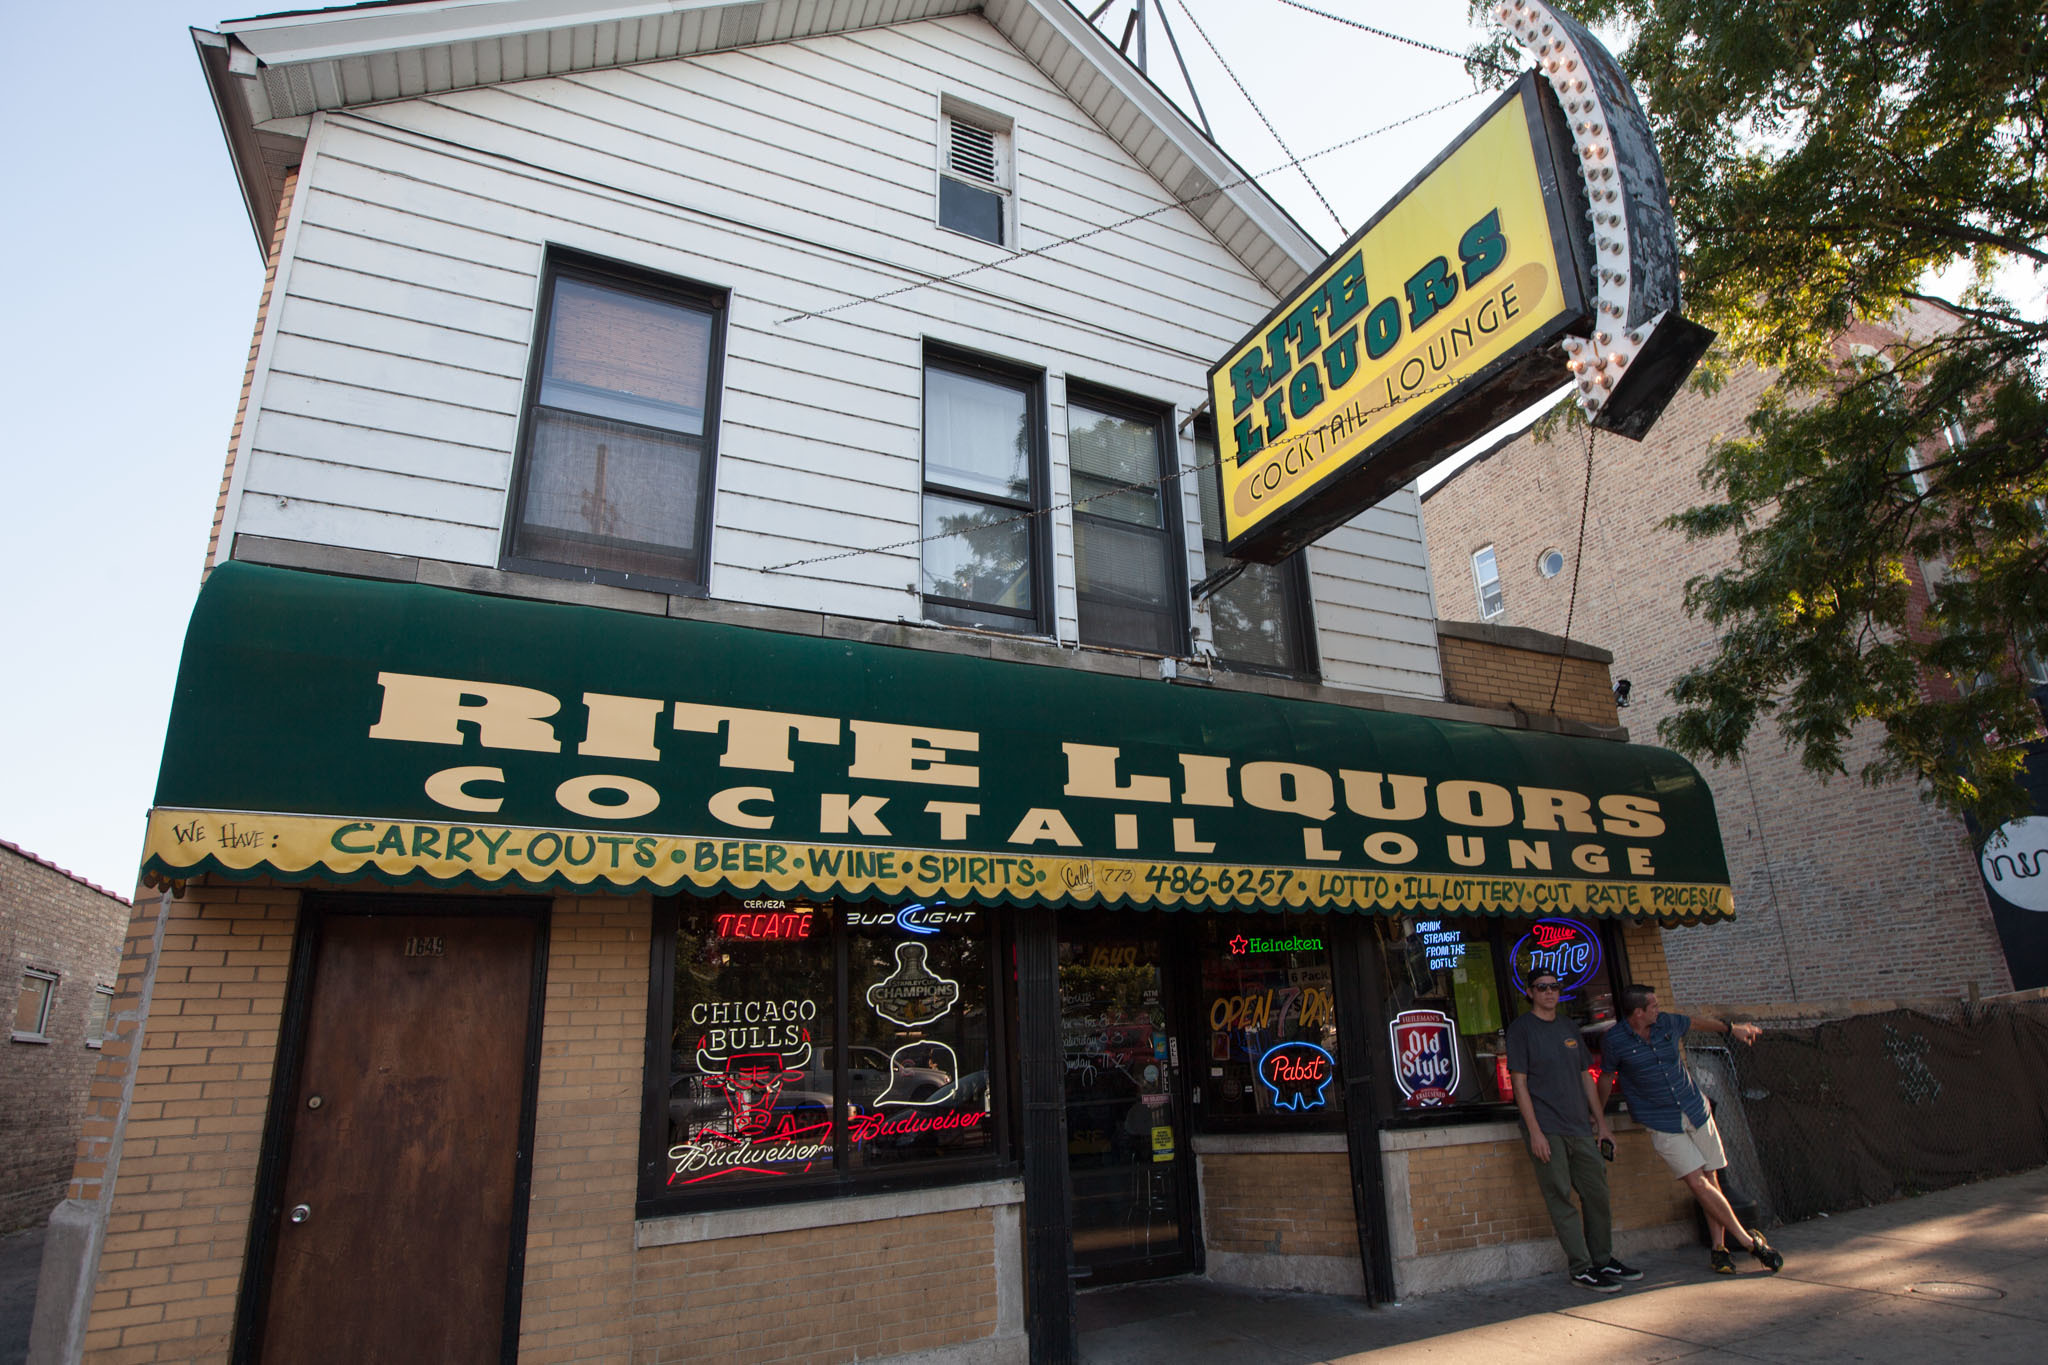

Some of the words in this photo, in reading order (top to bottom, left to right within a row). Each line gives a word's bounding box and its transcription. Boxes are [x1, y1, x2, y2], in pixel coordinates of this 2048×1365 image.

[1230, 249, 1370, 420] RITE
[1233, 207, 1507, 468] LIQUORS
[1250, 400, 1368, 500] COCKTAIL
[1385, 283, 1520, 404] LOUNGE
[369, 671, 980, 788] RITE
[1062, 741, 1666, 838] LIQUORS
[424, 766, 1216, 854] COCKTAIL
[1303, 827, 1656, 876] LOUNGE
[331, 822, 657, 868] CARRY-OUTS
[694, 842, 788, 876] BEER
[808, 847, 898, 879] WINE
[917, 856, 1035, 887] SPIRITS
[1066, 863, 1093, 888] Call
[1101, 864, 1136, 886] (773)
[1145, 865, 1293, 896] 486-6257
[1319, 874, 1389, 899] LOTTO
[1534, 883, 1572, 905] CUT
[1586, 884, 1640, 905] RATE
[1650, 886, 1722, 910] PRICES!!
[743, 899, 786, 910] CERVEZA
[717, 913, 813, 938] TECATE
[847, 912, 894, 926] BUD
[909, 911, 976, 925] LIGHT
[1416, 920, 1441, 934] DRINK
[1249, 936, 1324, 953] Heineken
[1424, 931, 1461, 945] STRAIGHT
[1533, 924, 1577, 944] Miller
[1426, 945, 1449, 958] FROM
[1450, 944, 1466, 955] THE
[1430, 956, 1458, 970] BOTTLE
[1302, 969, 1329, 981] Pack
[876, 984, 955, 1000] CHAMPIONS
[691, 999, 816, 1025] CHICAGO
[1210, 989, 1274, 1032] OPEN
[1278, 986, 1301, 1038] 7
[709, 1025, 799, 1051] BULLS
[1408, 1030, 1441, 1056] Old
[1270, 1055, 1326, 1081] Pabst
[1402, 1049, 1450, 1086] Style
[848, 1108, 987, 1143] Budweiser
[667, 1141, 827, 1174] Budweiser
